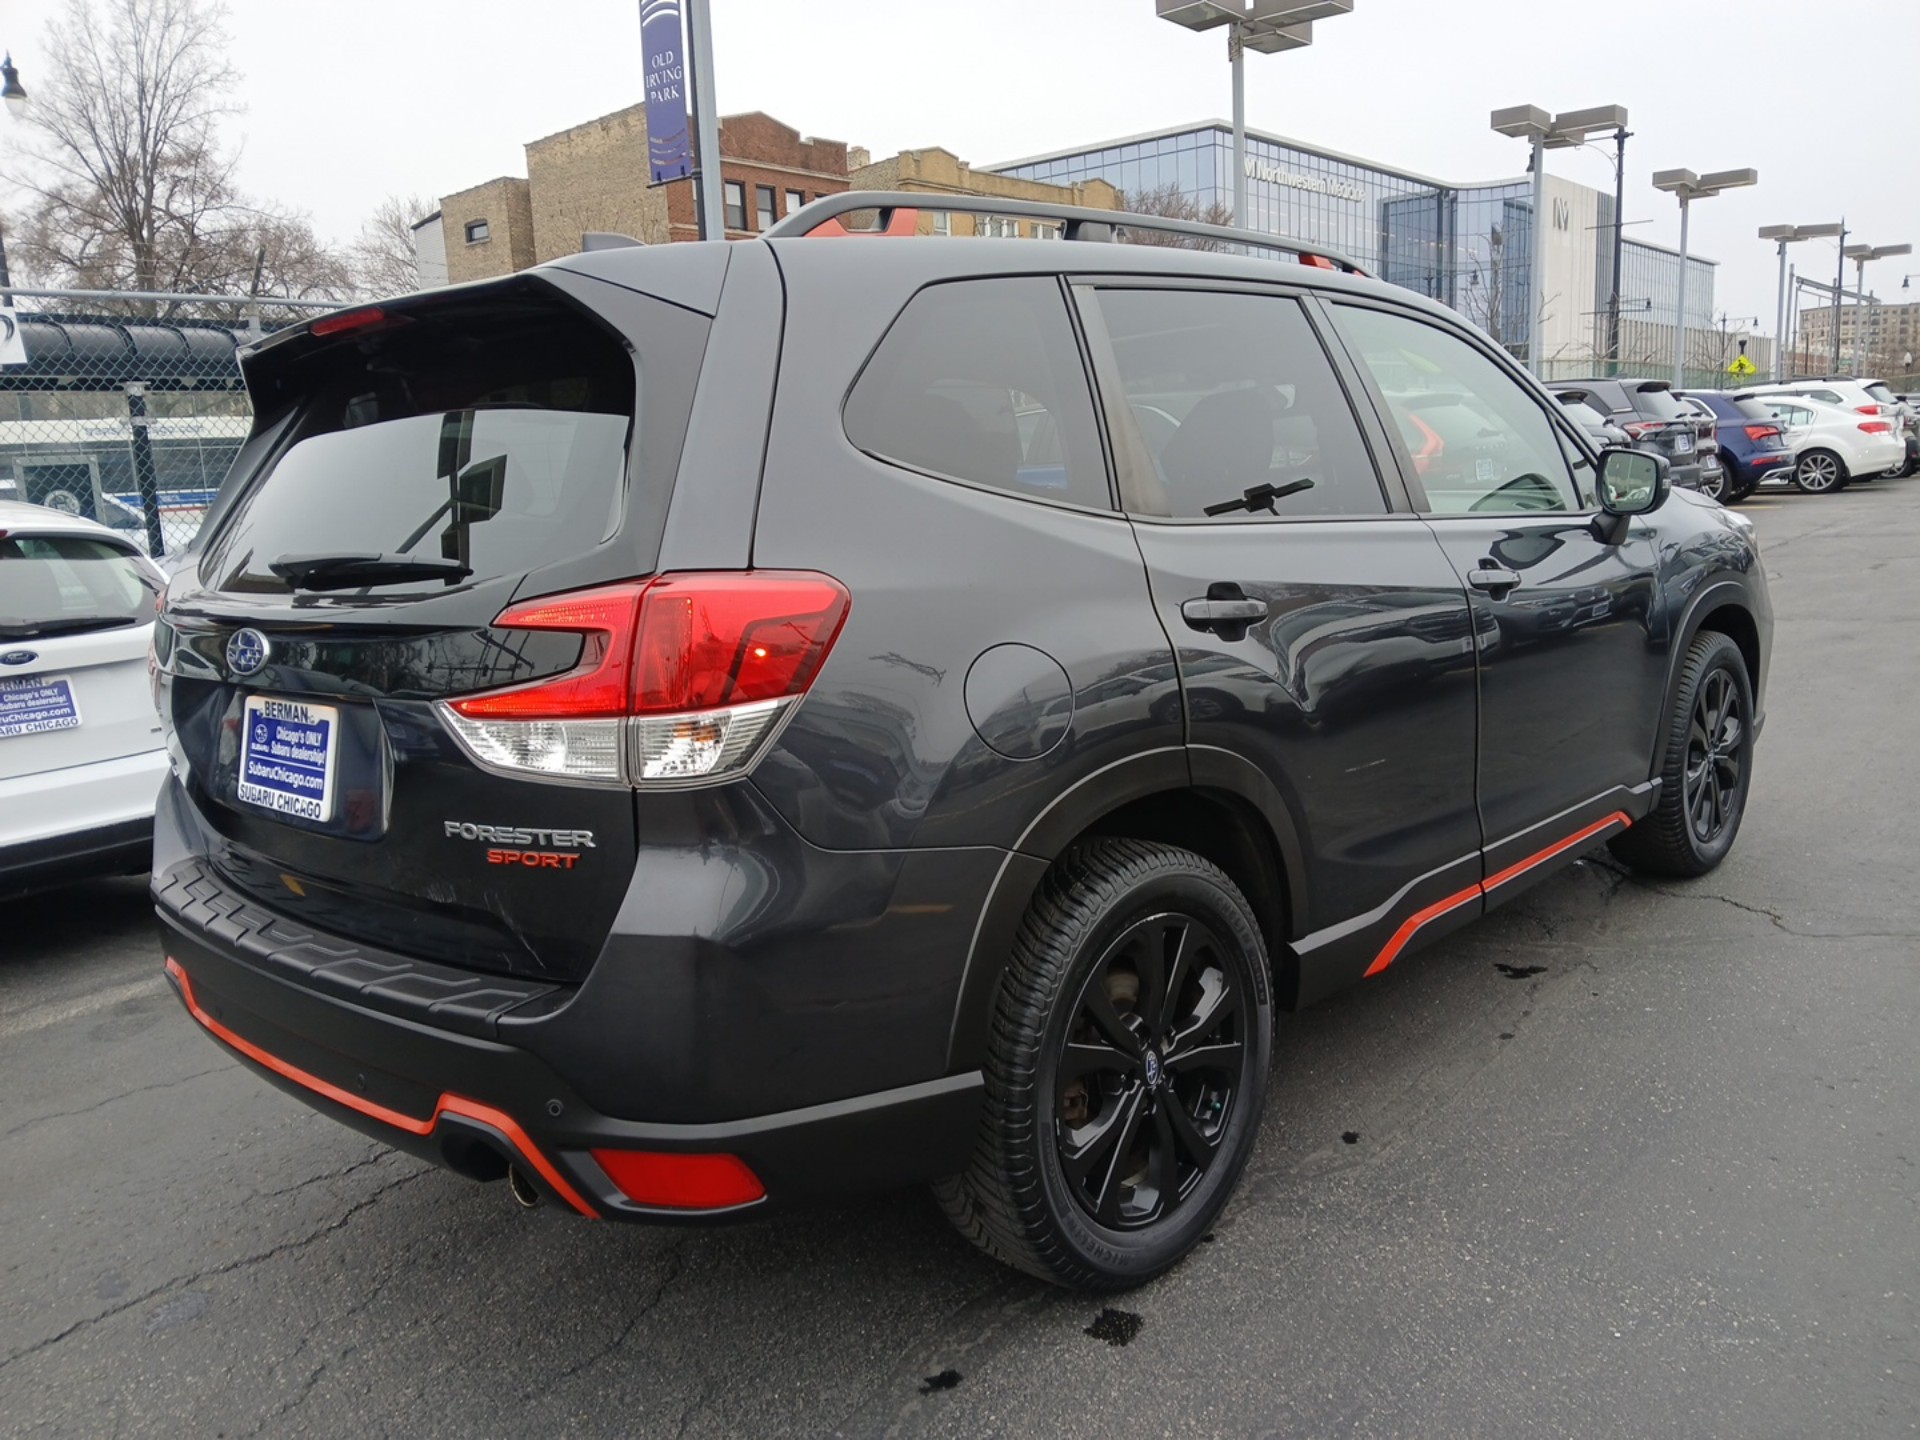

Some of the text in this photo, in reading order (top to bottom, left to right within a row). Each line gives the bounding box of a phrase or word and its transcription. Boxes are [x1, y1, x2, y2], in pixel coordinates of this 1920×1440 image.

[651, 50, 674, 69] OLD
[645, 65, 682, 89] IRVING
[650, 84, 680, 104] PARK
[1257, 160, 1327, 194] Northwestern
[40, 687, 59, 698] ONLY
[264, 700, 309, 723] BERMAN
[26, 717, 79, 732] CHICAGO
[275, 726, 322, 747] Chicago's ONLY
[271, 740, 326, 766] Subaru dealership!
[248, 760, 324, 789] SubaruChicago.com
[240, 783, 322, 819] SUBARU CHICAGO
[444, 820, 597, 848] FORESTER
[486, 848, 581, 869] SPORT
